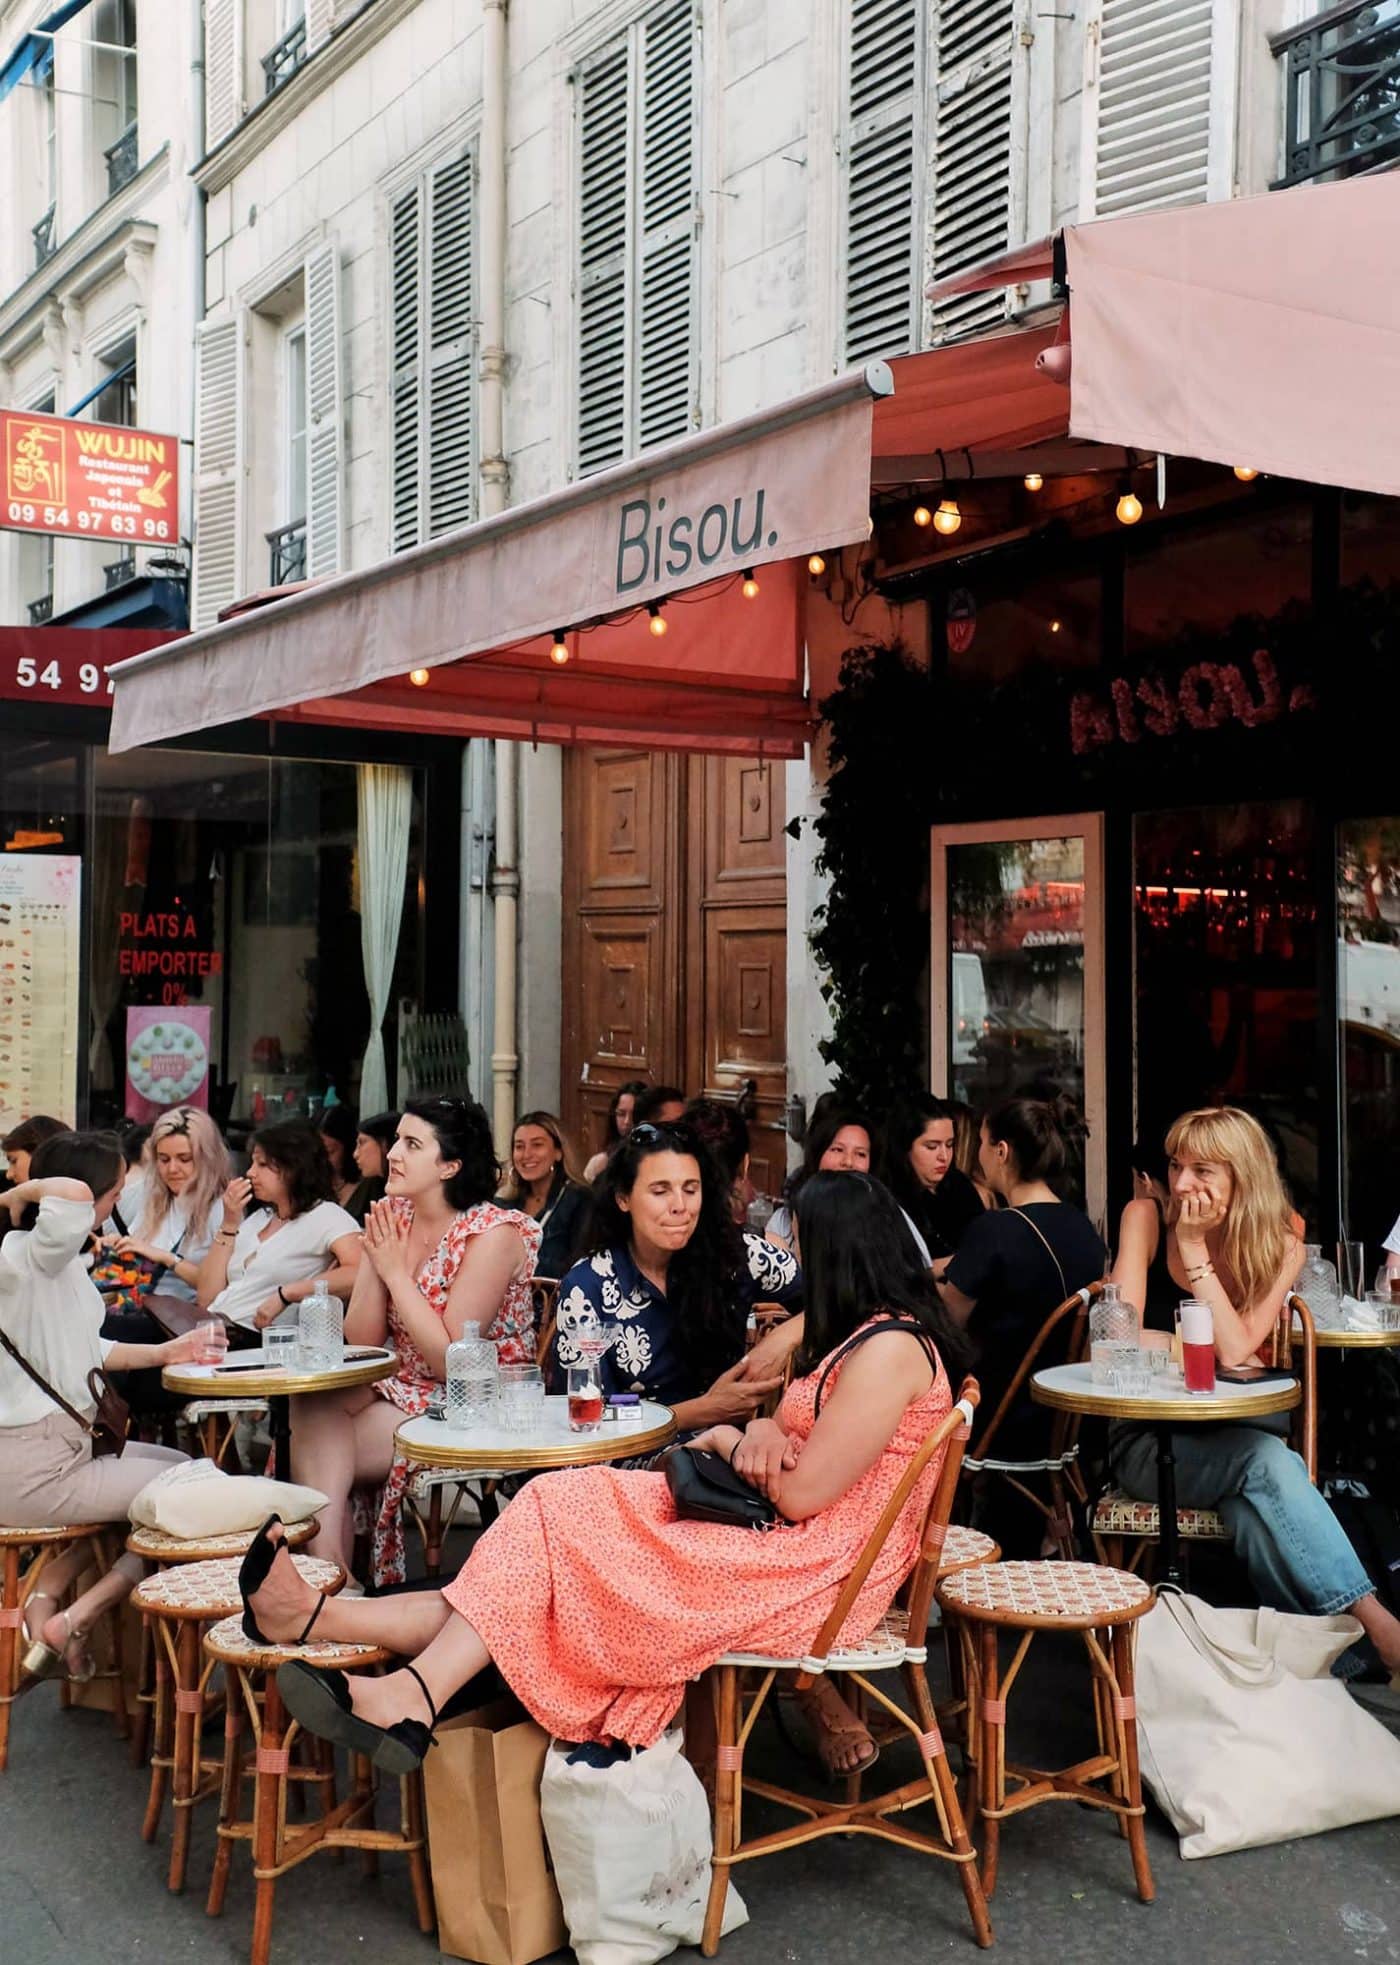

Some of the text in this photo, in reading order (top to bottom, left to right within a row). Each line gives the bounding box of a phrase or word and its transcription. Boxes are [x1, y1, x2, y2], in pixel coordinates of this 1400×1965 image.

[75, 430, 165, 464] WUJIN
[78, 455, 150, 475] Restaurant
[85, 469, 145, 487] Japonais
[88, 496, 142, 513] Tibétain
[107, 486, 122, 498] et
[8, 502, 169, 538] 09 54 97 63 96
[616, 489, 778, 593] Bisou.
[16, 657, 62, 690] 54
[120, 912, 197, 938] PLATS A
[119, 950, 223, 976] EMPORTER
